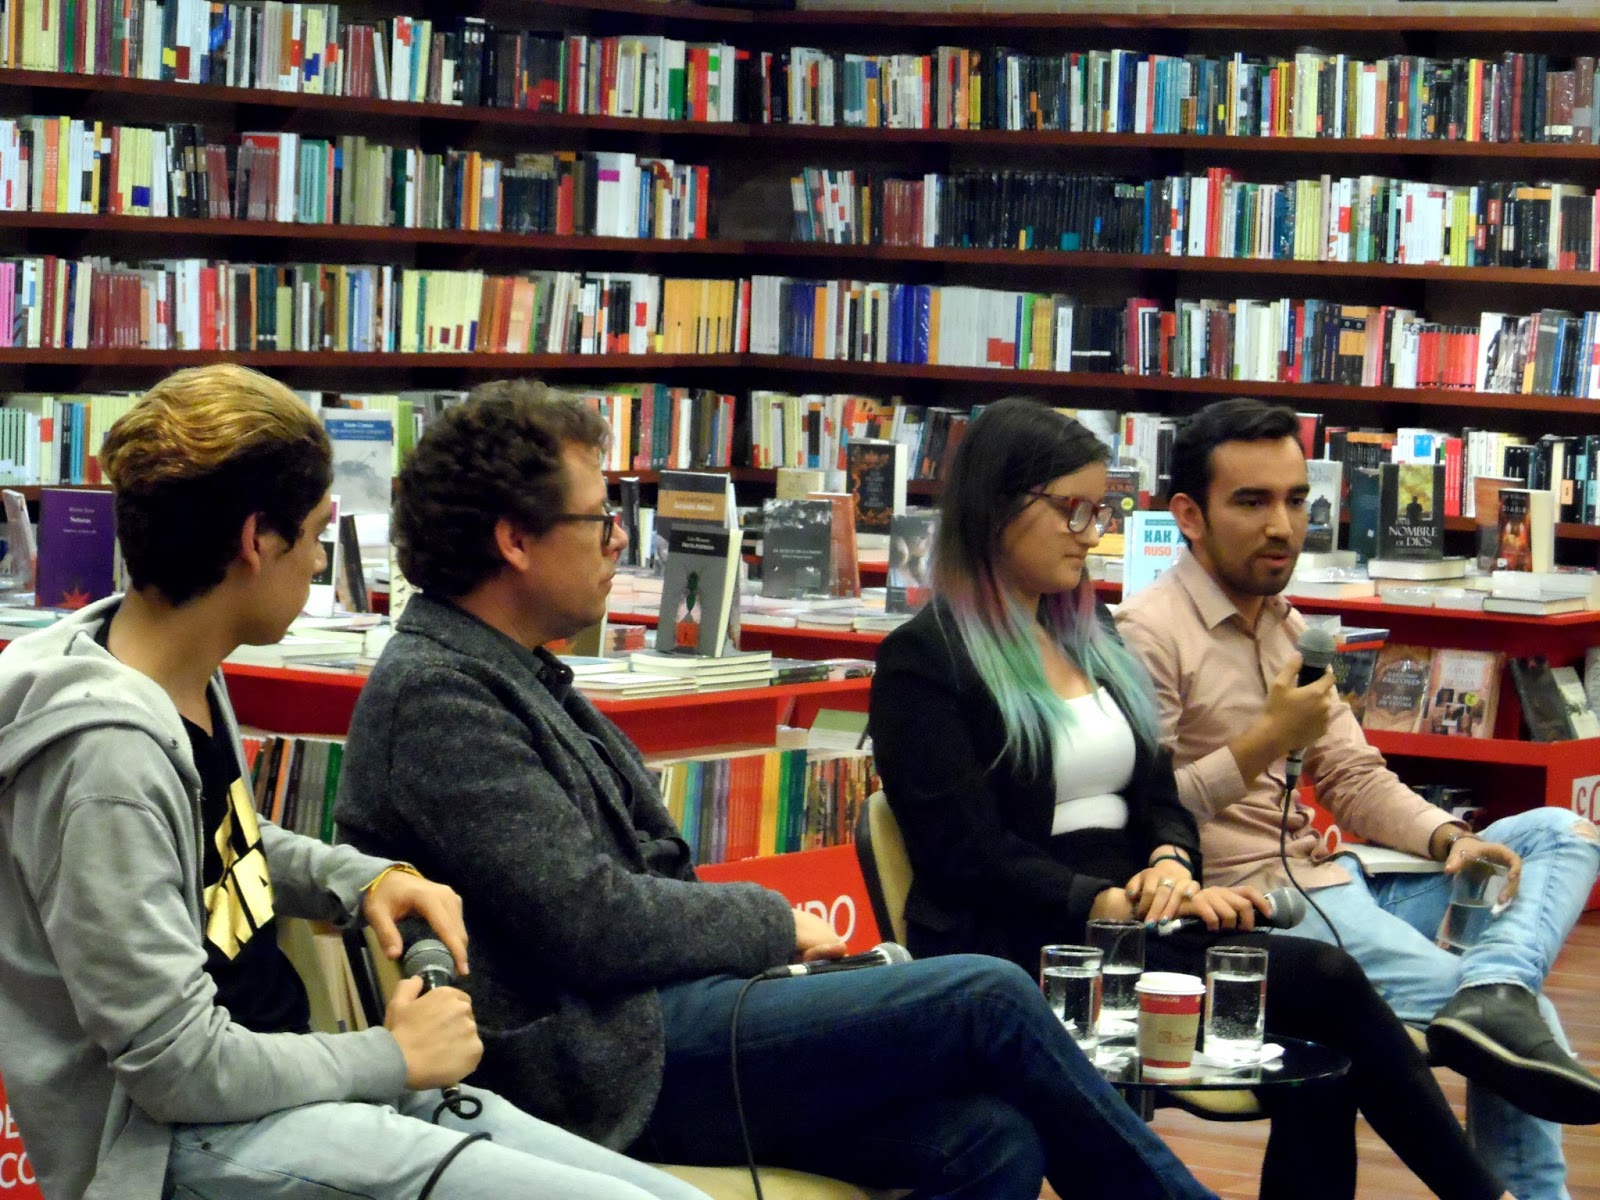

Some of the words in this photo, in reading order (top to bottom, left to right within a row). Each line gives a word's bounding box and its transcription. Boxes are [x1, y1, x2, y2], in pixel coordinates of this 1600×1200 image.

[1388, 525, 1439, 537] NOMBRE
[1406, 536, 1433, 547] DIOS
[1143, 545, 1172, 556] RUSO
